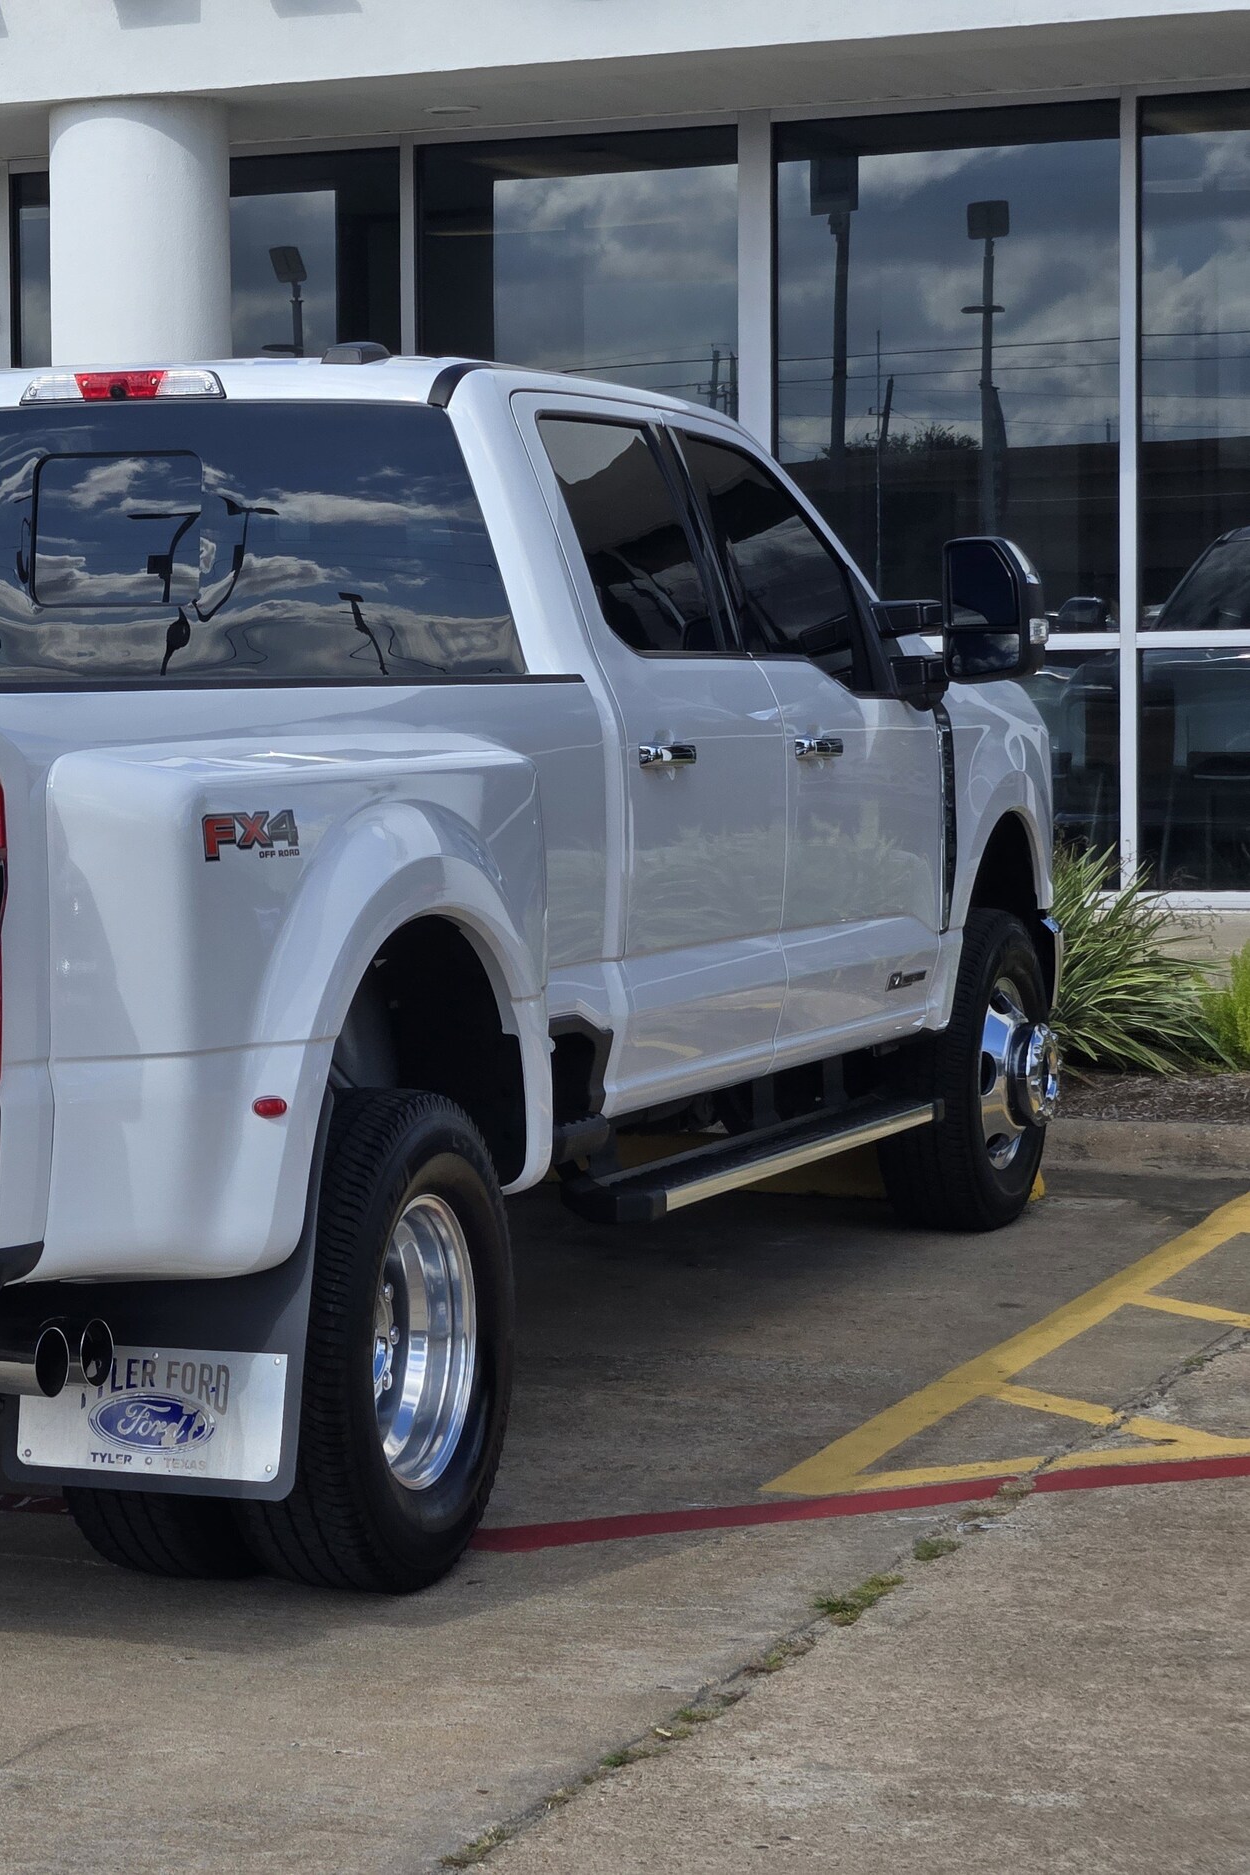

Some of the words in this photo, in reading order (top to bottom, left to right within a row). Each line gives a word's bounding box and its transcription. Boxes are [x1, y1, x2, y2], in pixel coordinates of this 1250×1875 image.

[202, 809, 299, 862] FX4
[259, 850, 276, 858] OFF
[278, 848, 300, 858] ROAD
[166, 1361, 230, 1415] FORD
[117, 1402, 187, 1440] Ford
[90, 1451, 133, 1465] TYLER
[163, 1456, 207, 1471] TEXAS
